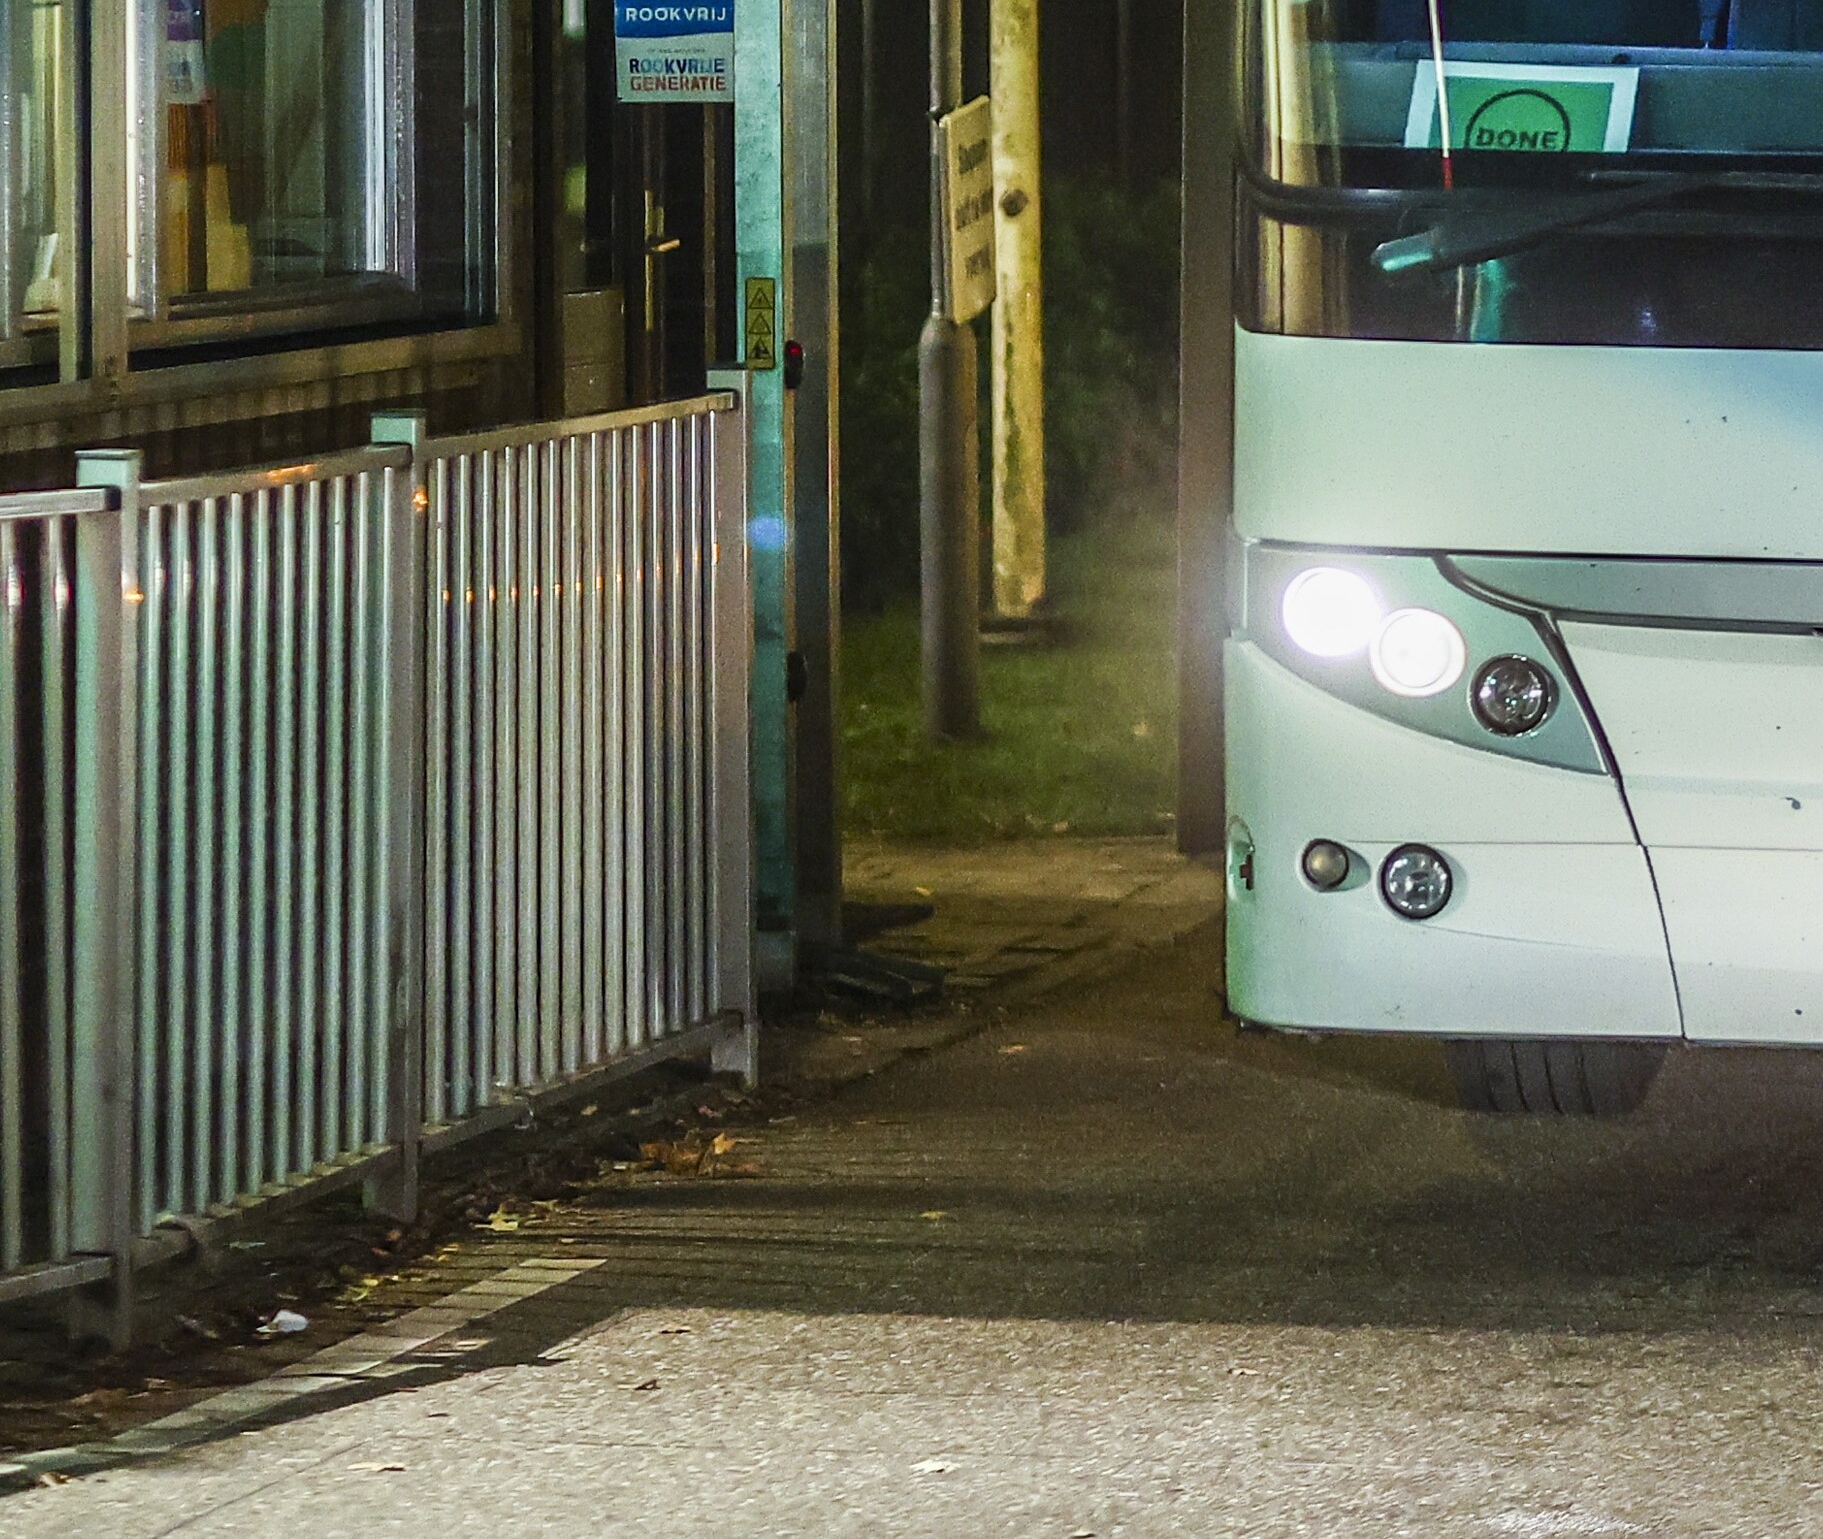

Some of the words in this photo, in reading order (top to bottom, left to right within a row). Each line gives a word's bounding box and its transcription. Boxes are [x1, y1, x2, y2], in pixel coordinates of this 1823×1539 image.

[625, 7, 727, 23] ROOKVRIJ
[629, 57, 725, 75] ROOKVRIJE
[630, 75, 726, 92] GENERATIE
[1476, 126, 1559, 149] DONE
